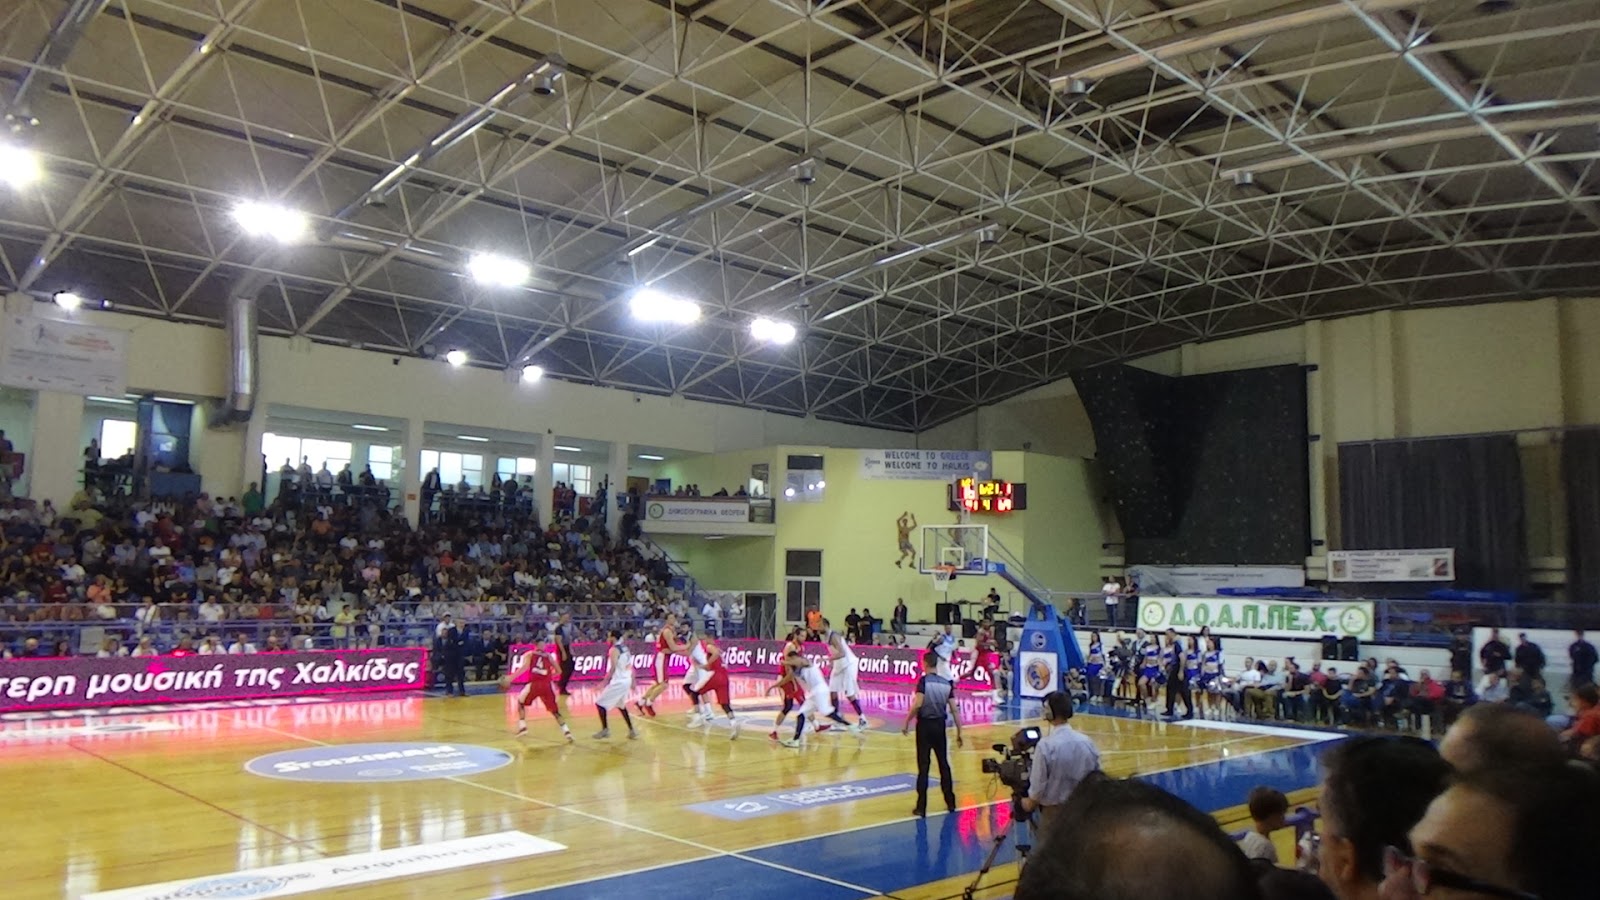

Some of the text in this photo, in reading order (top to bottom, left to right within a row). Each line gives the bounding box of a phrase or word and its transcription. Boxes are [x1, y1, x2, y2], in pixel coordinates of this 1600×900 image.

[884, 451, 920, 460] WELCOME
[925, 452, 936, 460] TO
[884, 461, 921, 470] WELCOME
[927, 462, 938, 470] TO
[942, 462, 970, 470] HALKIS
[756, 648, 767, 664] Η
[893, 660, 918, 680] της
[86, 664, 224, 698] μουσική
[234, 667, 285, 690] της
[291, 658, 419, 684] Χαλκίδας
